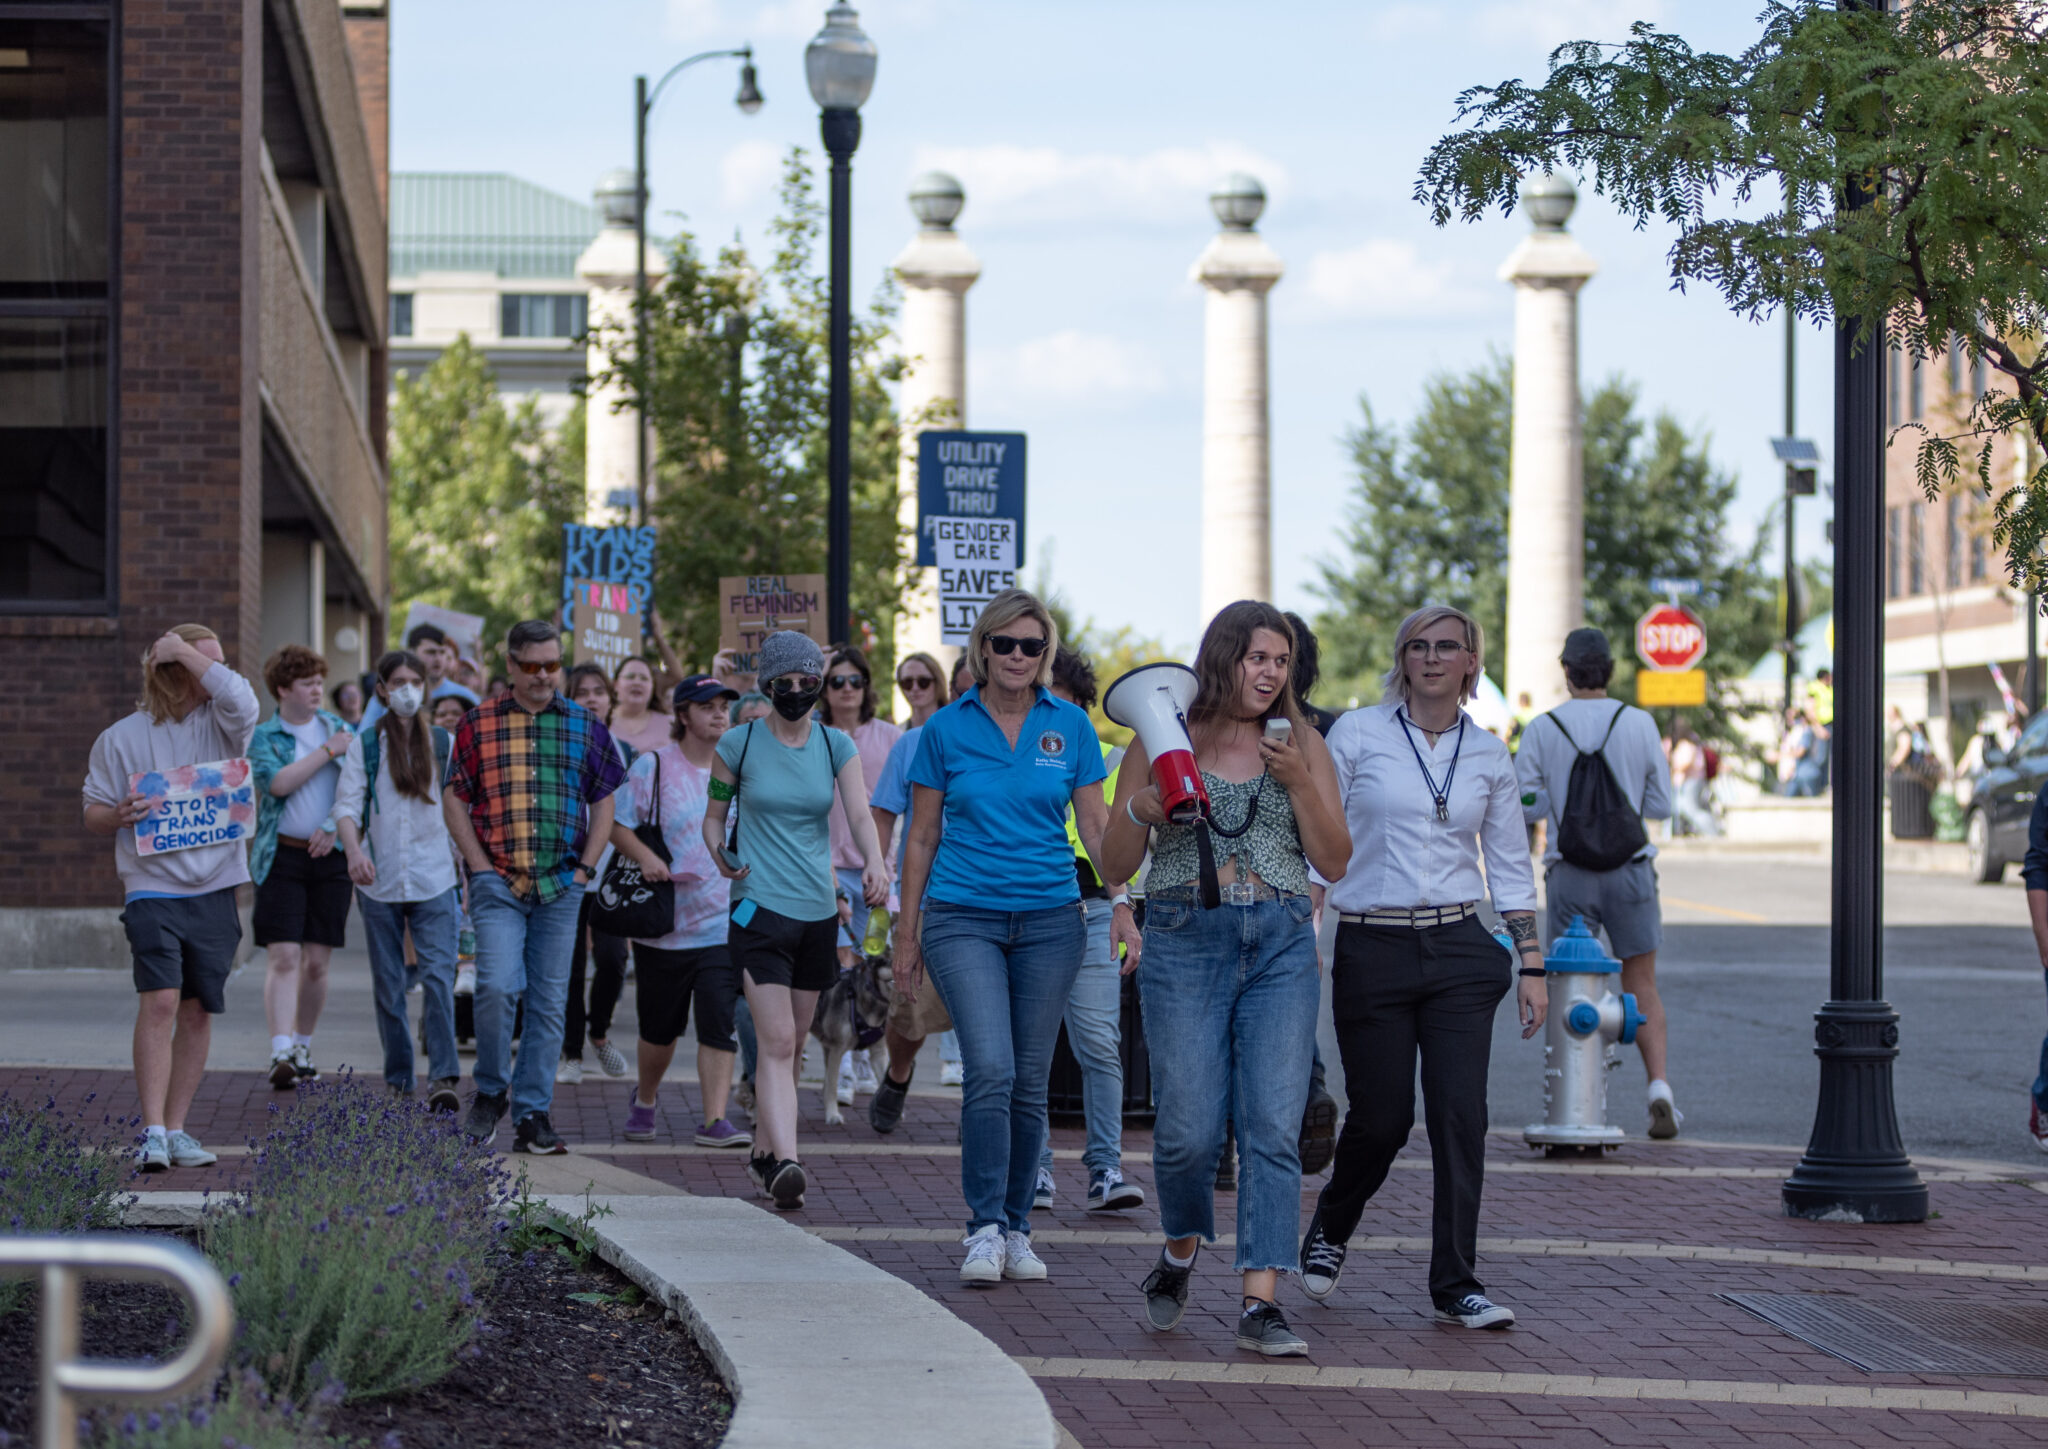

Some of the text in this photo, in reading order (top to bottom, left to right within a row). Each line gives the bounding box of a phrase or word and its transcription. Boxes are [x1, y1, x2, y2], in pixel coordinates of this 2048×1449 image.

[938, 440, 1006, 464] UTILITY
[943, 466, 999, 490] DRIVE
[947, 491, 997, 515] THRU
[562, 522, 656, 551] TRANS
[938, 521, 1011, 543] GENDER
[565, 549, 651, 578] KIDS
[954, 543, 1000, 560] CARE
[746, 576, 793, 595] REAL
[941, 568, 1015, 594] SAVES
[577, 583, 640, 616] TRANS
[729, 591, 819, 614] FEMINISM
[594, 611, 619, 633] KID
[764, 614, 779, 629] IS
[1645, 623, 1701, 654] STOP
[159, 795, 217, 816] STOP
[148, 809, 218, 834] TRANS
[152, 823, 242, 851] GENOCIDE
